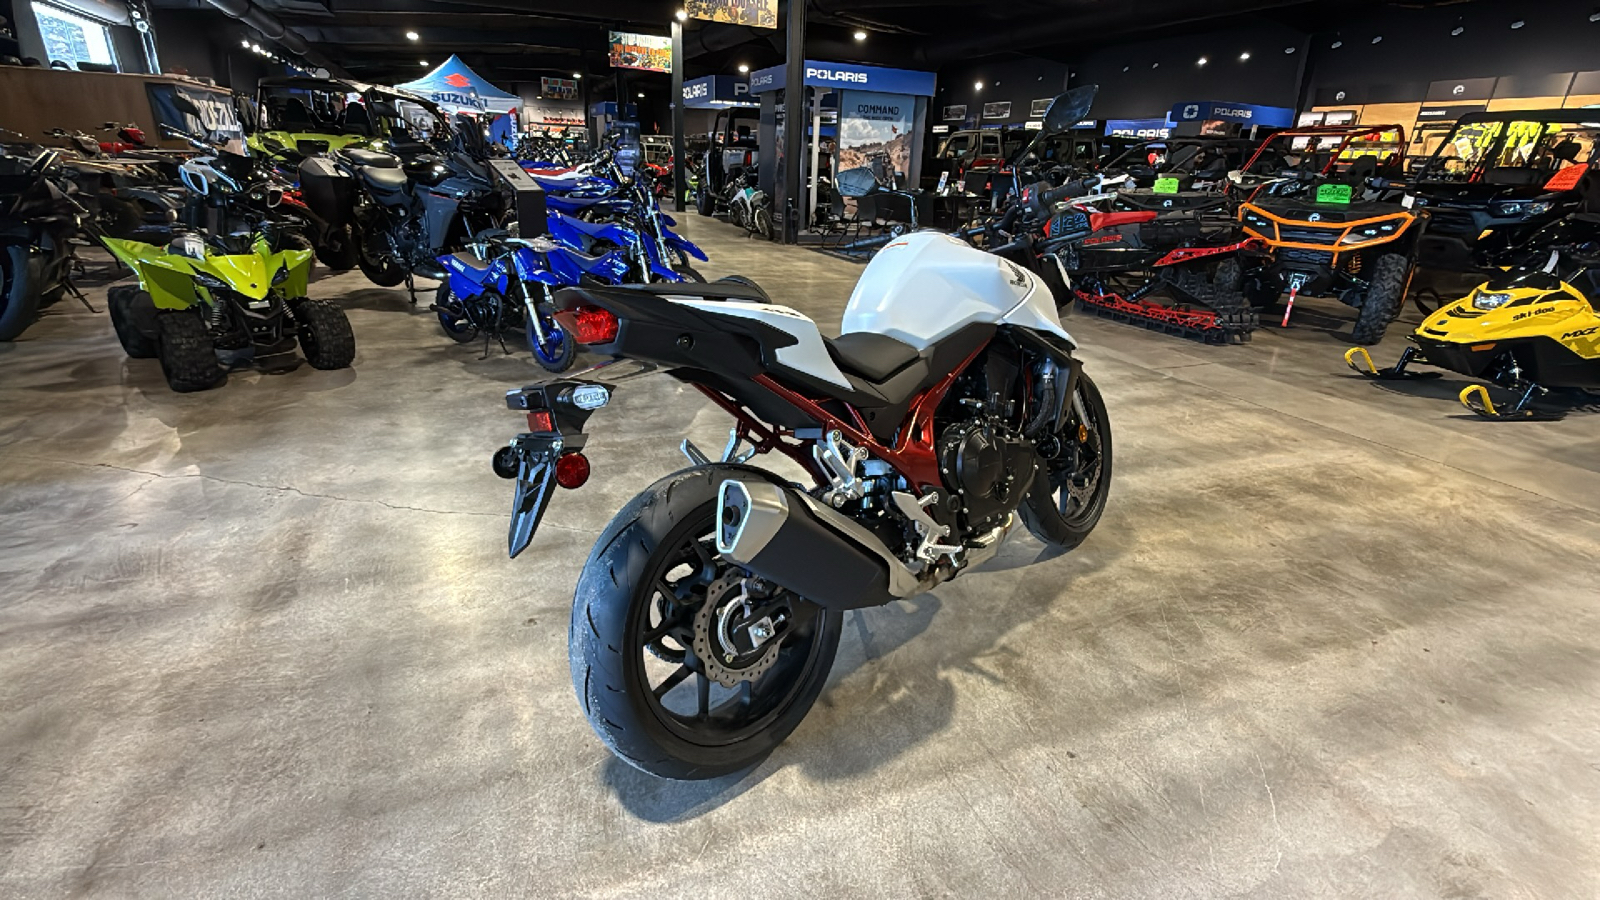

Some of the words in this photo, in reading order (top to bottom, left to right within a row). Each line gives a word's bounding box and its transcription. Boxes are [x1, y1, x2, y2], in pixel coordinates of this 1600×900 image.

[751, 75, 773, 87] POLARIS
[806, 68, 868, 83] POLARIS
[431, 93, 488, 108] SUZUKI
[857, 104, 900, 115] COMMAND
[1214, 107, 1253, 119] POLARIS
[509, 113, 519, 149] SUZUKI
[1513, 307, 1555, 321] ski-doo
